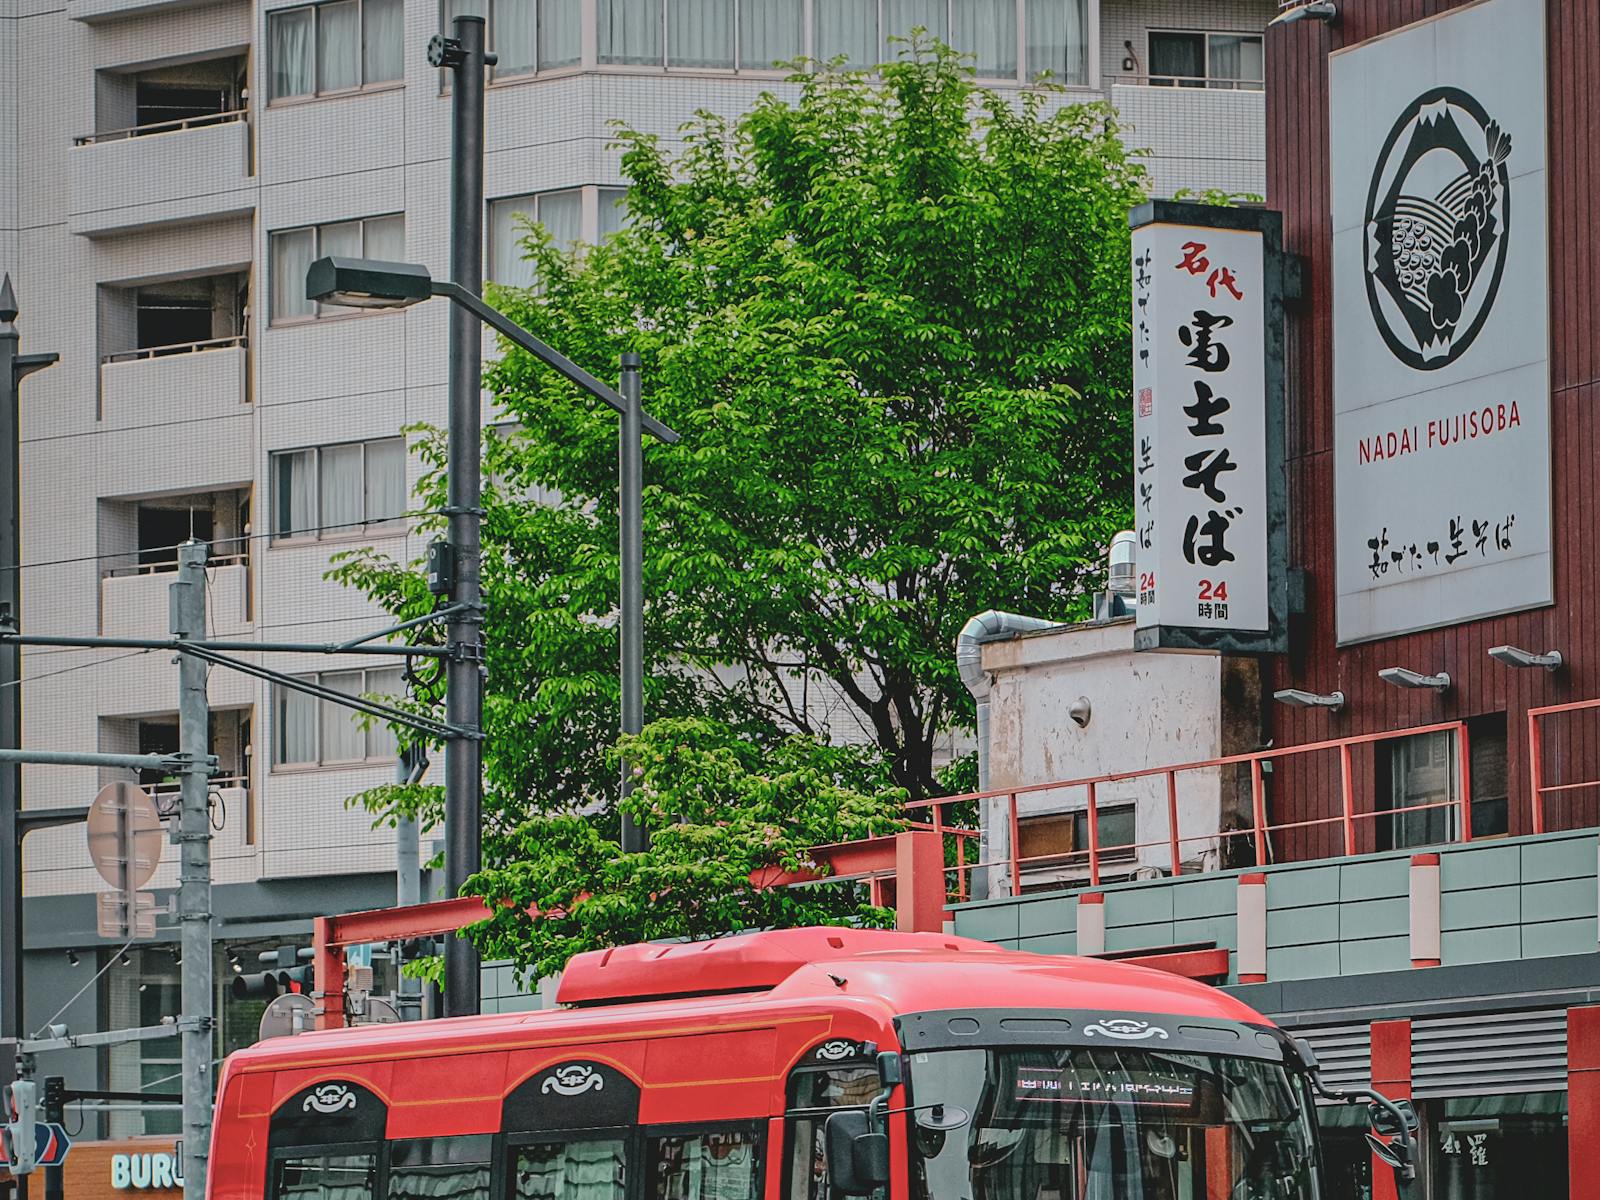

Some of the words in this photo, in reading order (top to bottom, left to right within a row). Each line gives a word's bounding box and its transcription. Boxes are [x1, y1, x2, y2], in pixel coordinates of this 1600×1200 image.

[1175, 241, 1244, 300] 名代
[1178, 309, 1244, 567] 富士そば
[1359, 425, 1418, 465] NADAI
[1427, 401, 1521, 448] FUJISOBA
[1140, 572, 1155, 589] 24
[1198, 579, 1228, 601] 24
[1198, 603, 1229, 620] 時間
